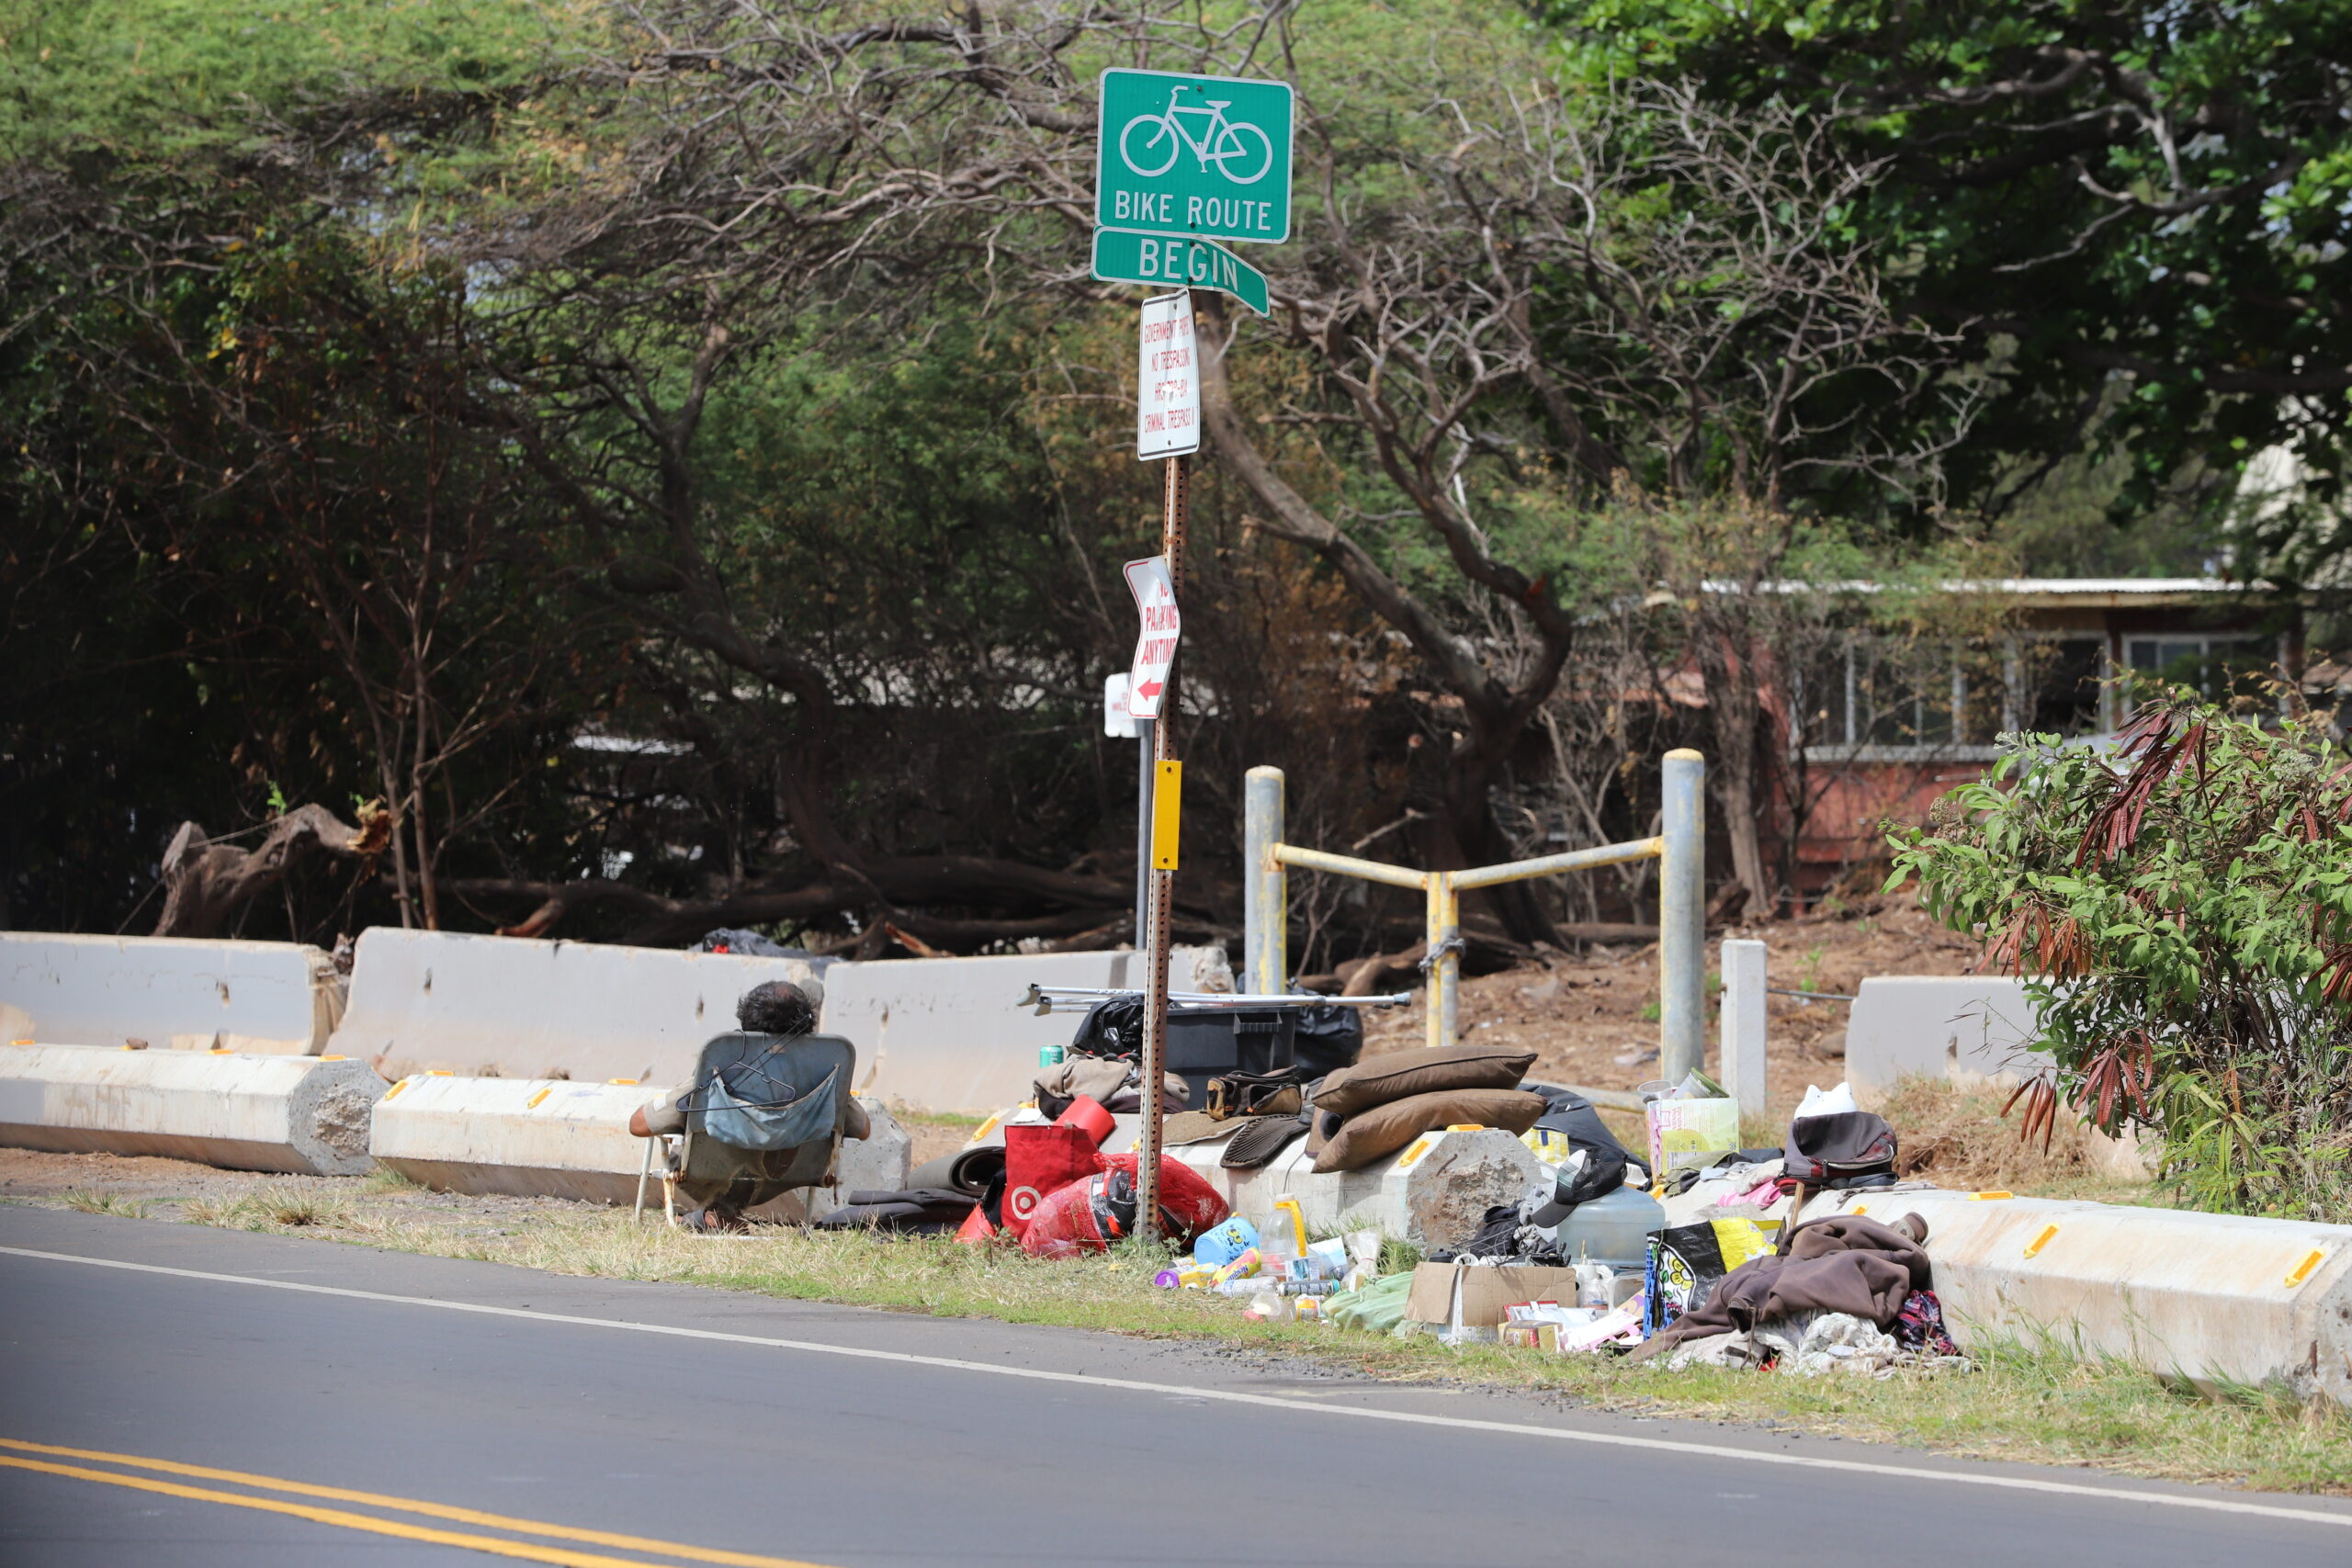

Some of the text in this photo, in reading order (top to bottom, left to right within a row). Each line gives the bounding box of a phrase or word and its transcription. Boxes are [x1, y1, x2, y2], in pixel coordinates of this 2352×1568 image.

[1114, 190, 1272, 231] BIKE ROUTE
[1138, 238, 1238, 293] BEGIN
[1144, 320, 1177, 344] GOVERNMENT
[1151, 346, 1191, 372] NO TRESPASSING
[1144, 412, 1166, 434] CRIMINAL
[1168, 408, 1191, 430] TRESPASS
